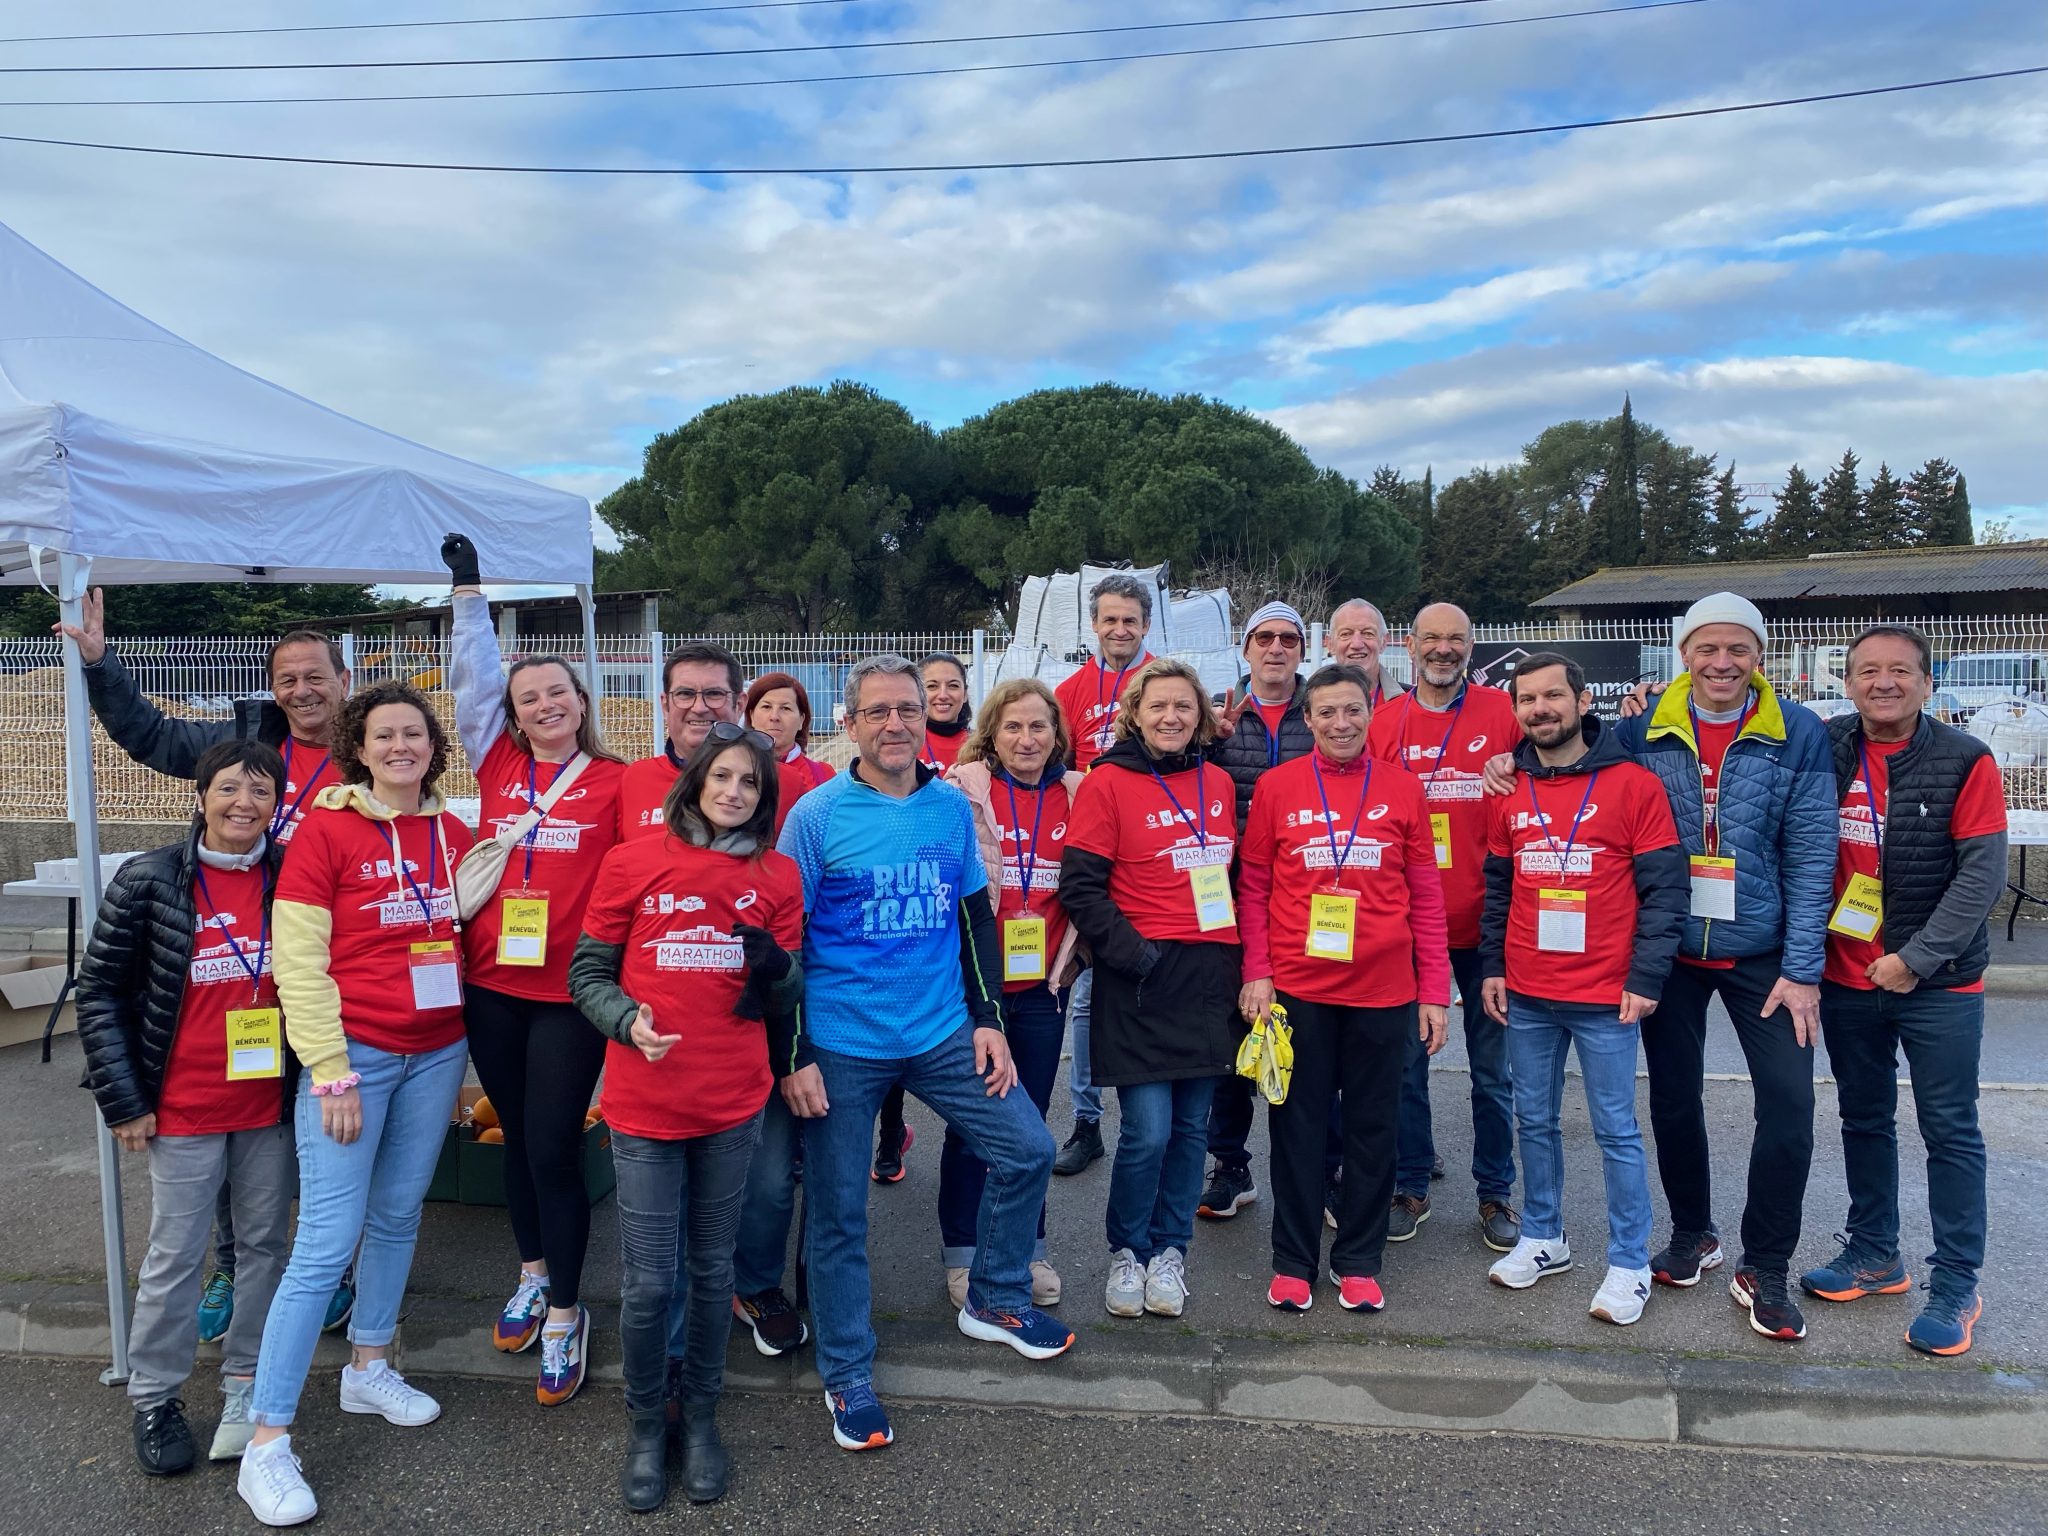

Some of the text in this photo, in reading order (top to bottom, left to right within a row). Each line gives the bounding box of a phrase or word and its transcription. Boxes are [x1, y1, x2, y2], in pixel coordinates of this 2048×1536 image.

[1585, 682, 1635, 696] mmo
[1598, 701, 1618, 710] Neuf
[1594, 712, 1621, 721] Gestio
[1426, 783, 1481, 793] ARATHON
[499, 826, 577, 842] MTHON
[1307, 849, 1379, 861] MARAHON
[873, 861, 941, 901] RUN
[384, 900, 451, 917] MARAHO
[662, 900, 671, 908] M
[396, 911, 441, 920] MONTPELIER
[862, 895, 946, 932] TRAIL
[660, 947, 743, 961] MARATHON
[1010, 943, 1038, 951] BÉNÉVOLE
[195, 954, 272, 976] MARAHO
[235, 1036, 271, 1046] BÉNÉVOLE
[1533, 1249, 1551, 1269] N
[1633, 1281, 1650, 1301] N
